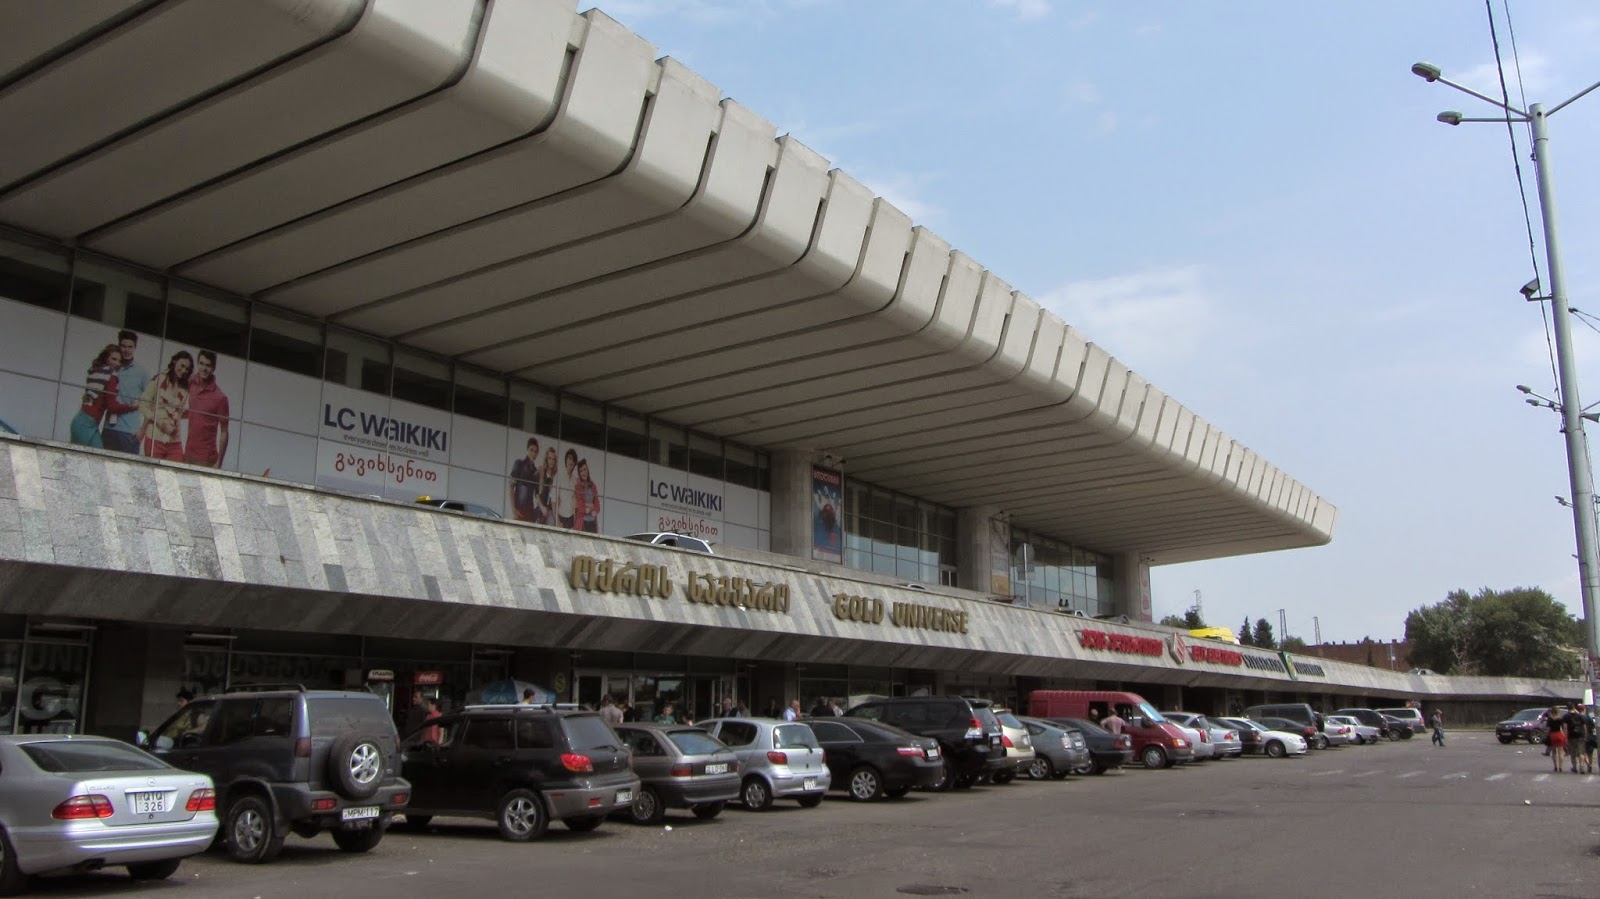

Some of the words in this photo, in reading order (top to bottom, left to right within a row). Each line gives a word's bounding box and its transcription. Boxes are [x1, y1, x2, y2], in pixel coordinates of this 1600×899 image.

[324, 404, 355, 431] LC
[343, 434, 371, 446] everyone
[650, 480, 668, 499] LC
[834, 592, 885, 625] GOLD
[892, 601, 969, 634] UNIVERSE
[143, 801, 163, 812] 326
